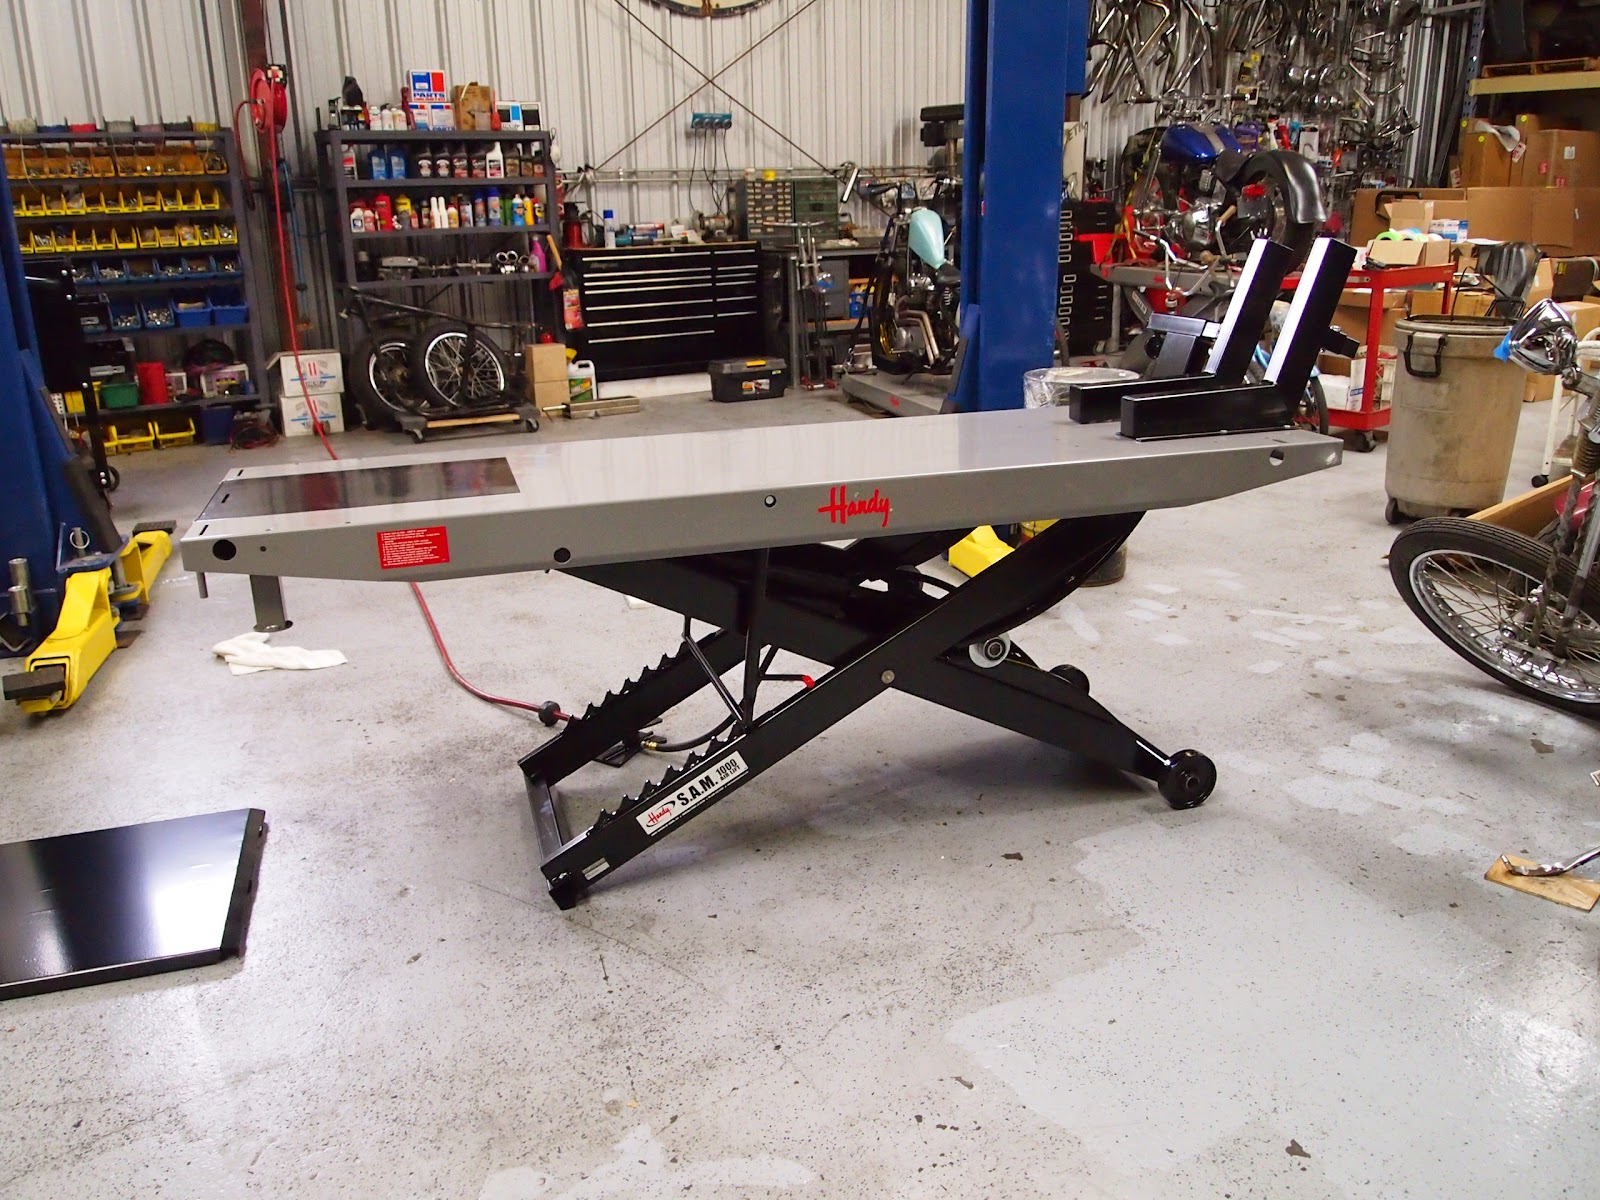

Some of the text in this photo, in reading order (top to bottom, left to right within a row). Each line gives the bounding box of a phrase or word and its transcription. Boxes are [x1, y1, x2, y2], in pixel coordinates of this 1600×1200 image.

[818, 485, 889, 527] Handy
[715, 759, 737, 776] 1000
[720, 765, 741, 781] AIR LIFT
[647, 775, 718, 824] Handy S.A.M.
